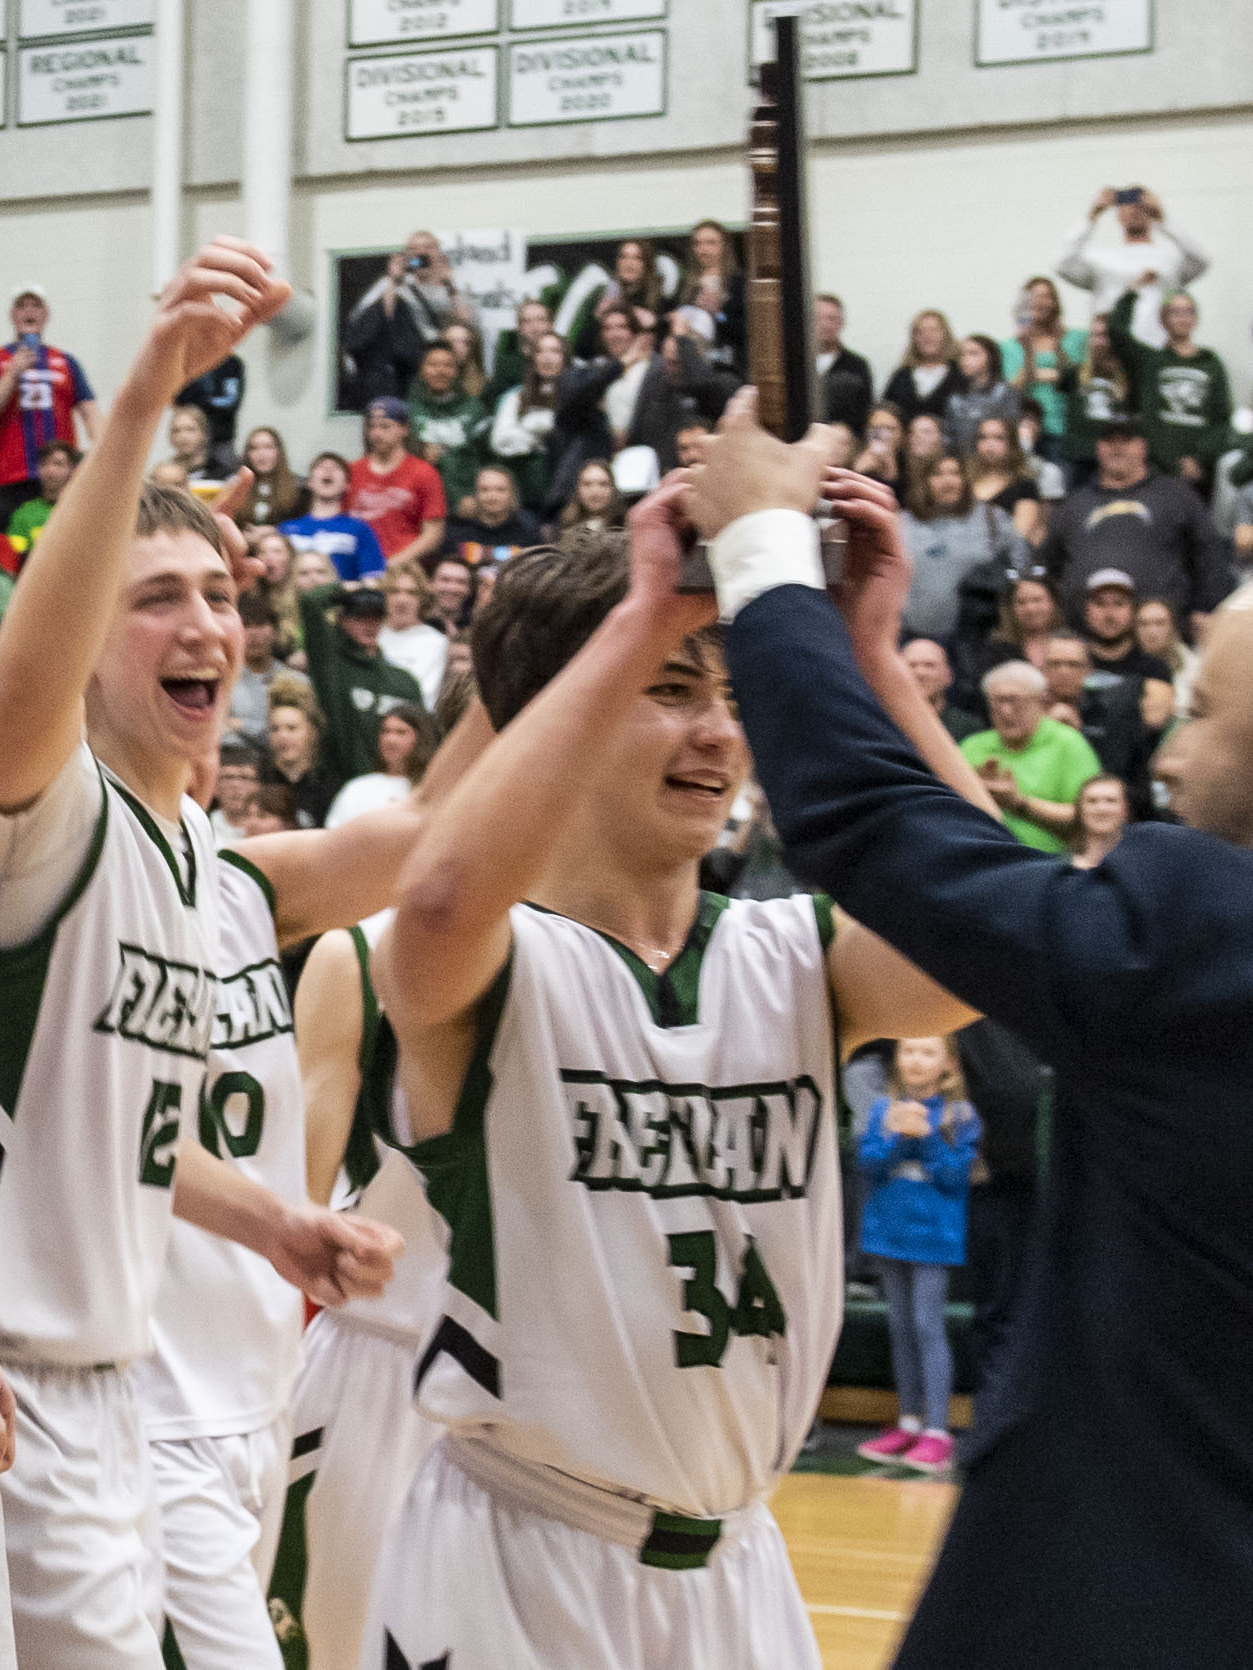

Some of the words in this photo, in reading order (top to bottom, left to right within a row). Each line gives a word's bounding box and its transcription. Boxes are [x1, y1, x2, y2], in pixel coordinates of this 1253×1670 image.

[29, 45, 143, 74] REGIONAL
[356, 58, 485, 88] DIVISIONAL
[515, 43, 655, 74] DIVISIONAL
[51, 72, 121, 92] CHAMPS
[385, 84, 459, 106] CHAMPS
[548, 71, 623, 91] CHAMPS
[657, 1230, 788, 1368] 34
